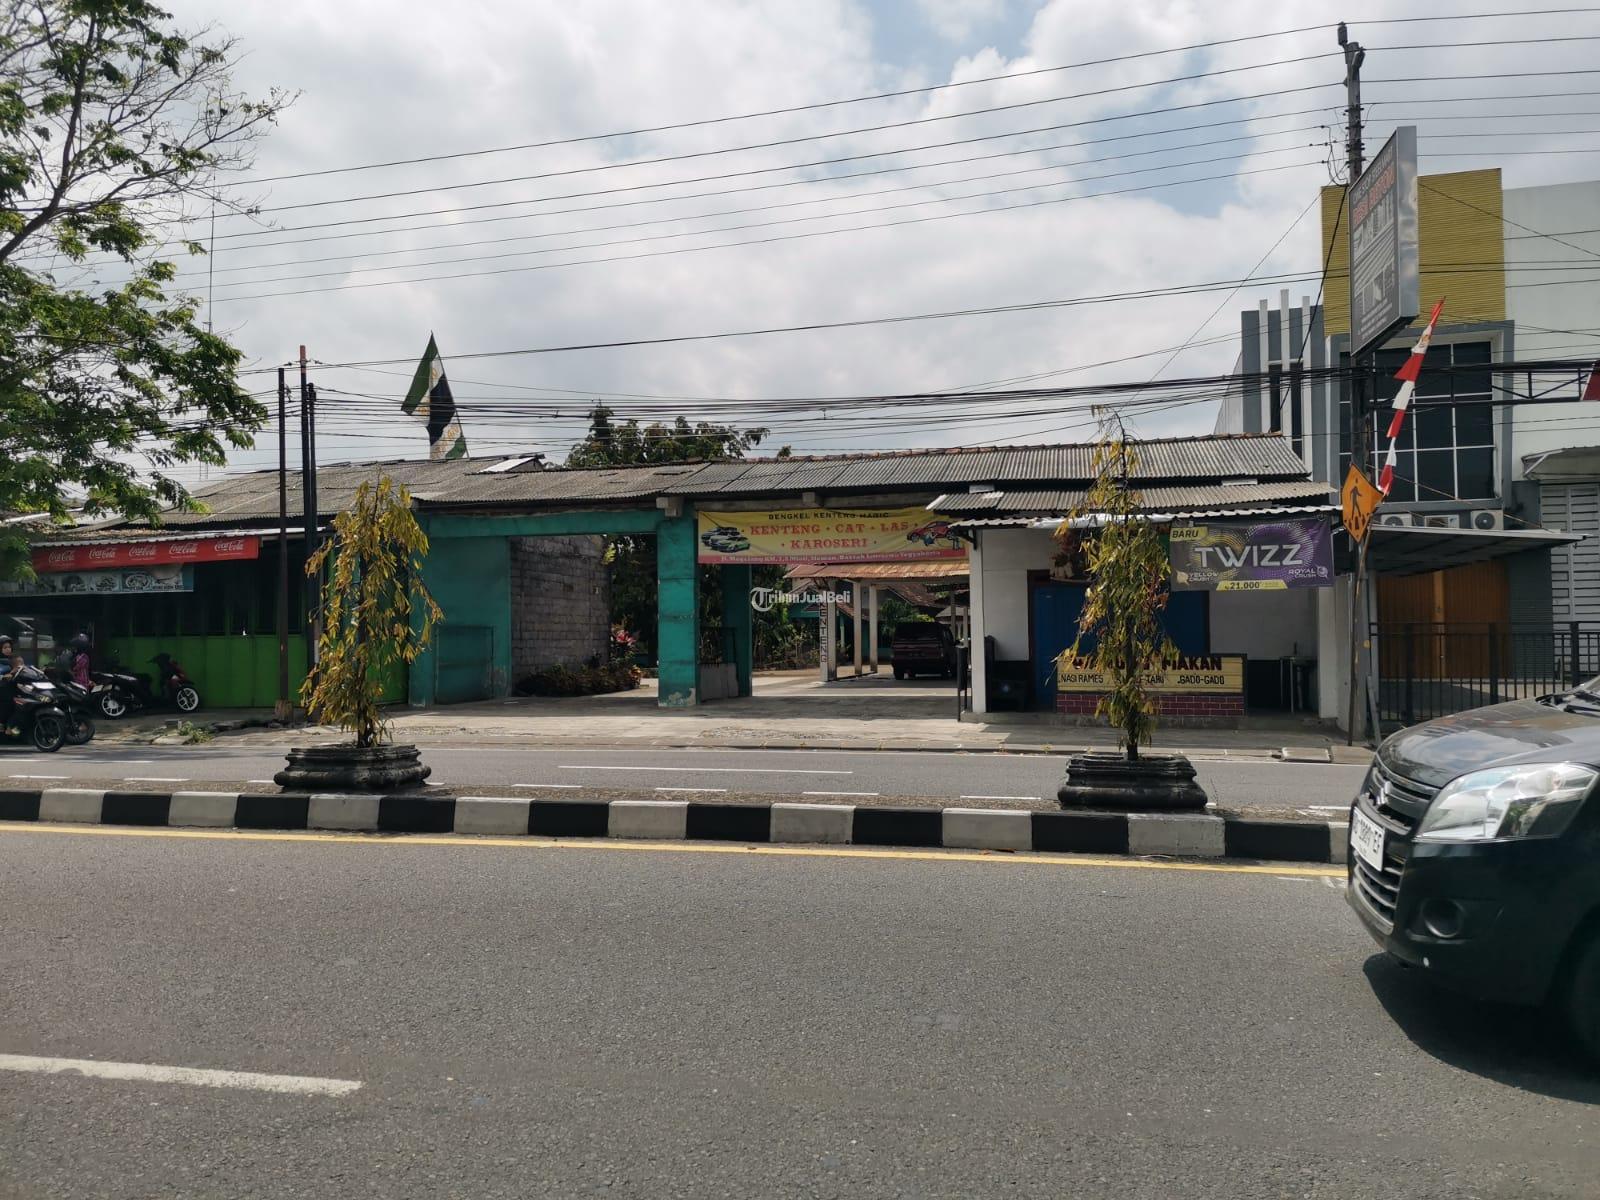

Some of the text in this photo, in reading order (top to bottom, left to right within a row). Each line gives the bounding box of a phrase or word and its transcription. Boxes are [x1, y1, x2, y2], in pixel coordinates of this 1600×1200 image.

[768, 512, 810, 521] BENGKEL
[750, 522, 910, 536] KENTENG CAT LAS
[1171, 528, 1200, 539] BARU
[168, 543, 198, 555] Coca-Cola
[214, 539, 245, 551] Coca-Cola
[790, 539, 868, 550] KAROSERI
[88, 547, 117, 560] Coca-Cola
[1194, 543, 1304, 568] TWIZZ
[1230, 581, 1260, 590] 21.000
[1161, 656, 1222, 671] MAKAN
[1061, 674, 1077, 683] NASI
[1079, 674, 1104, 683] RAMES
[1178, 675, 1225, 685] GADO-GADO
